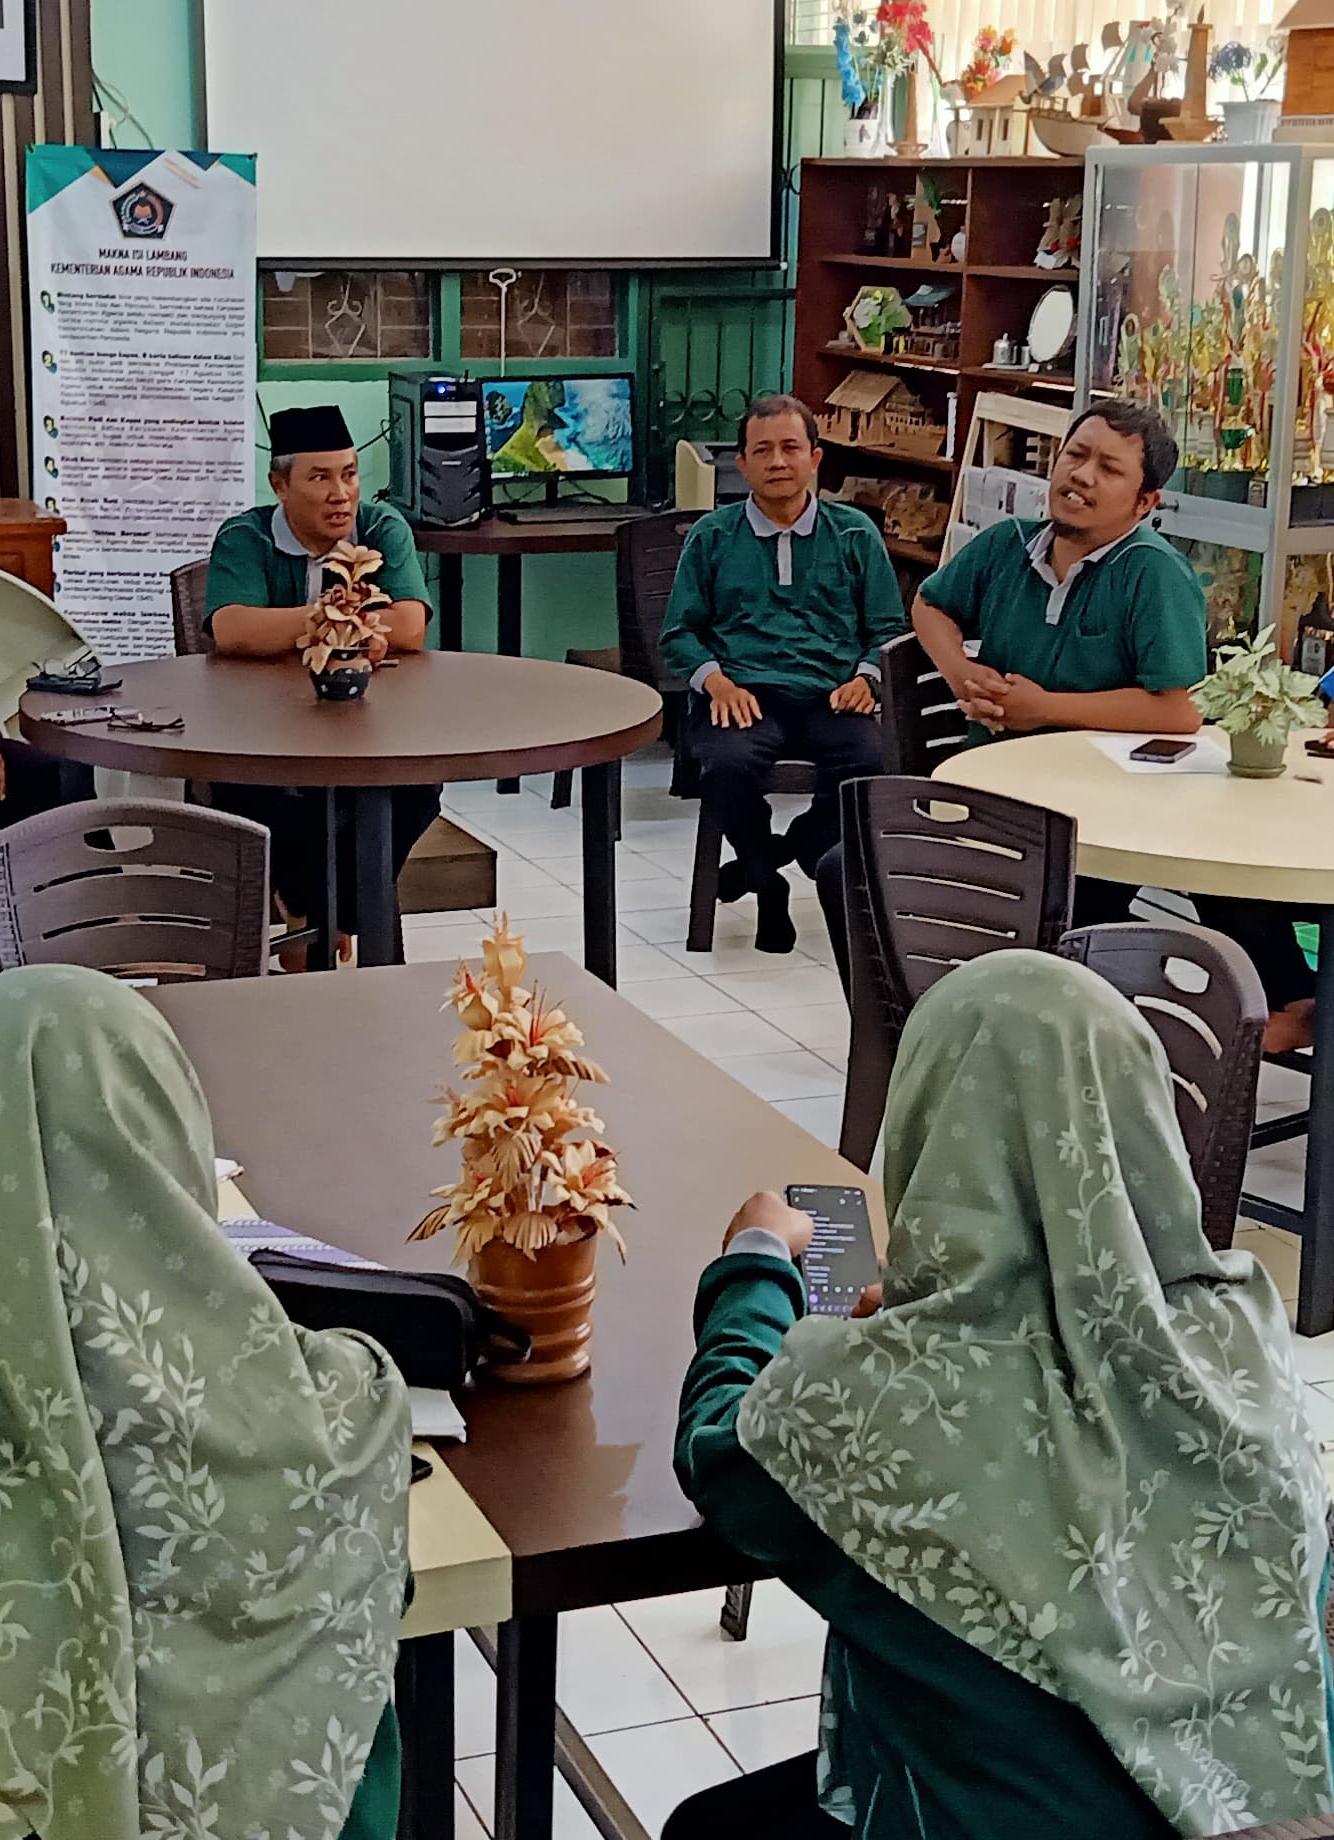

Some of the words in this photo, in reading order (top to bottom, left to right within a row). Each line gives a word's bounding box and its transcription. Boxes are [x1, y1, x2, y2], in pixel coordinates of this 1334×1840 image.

[98, 249, 129, 260] MAKNA
[132, 249, 143, 260] ISI
[146, 250, 188, 262] LAMBANG
[50, 262, 111, 276] KEMENTERIAN
[113, 264, 143, 277] AGAMA
[146, 265, 188, 278] REPUBLIK
[190, 266, 235, 280] INDONESIA
